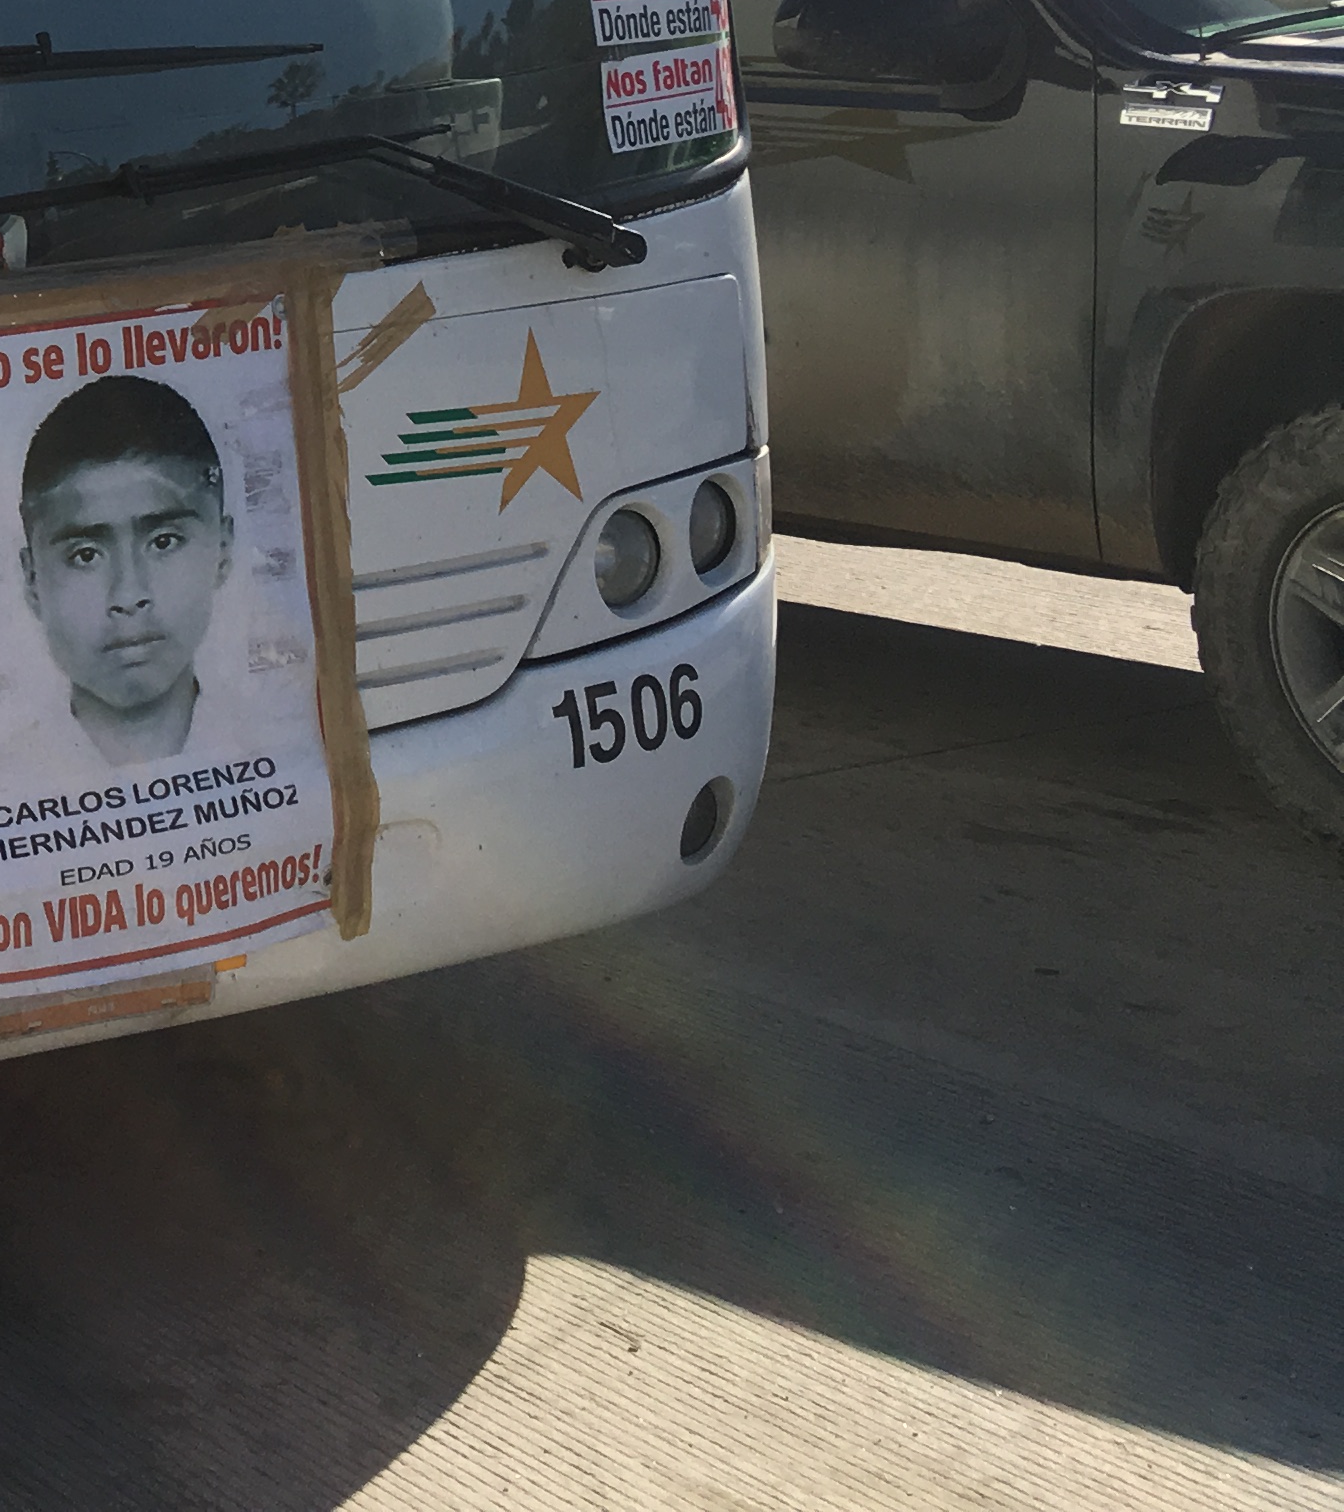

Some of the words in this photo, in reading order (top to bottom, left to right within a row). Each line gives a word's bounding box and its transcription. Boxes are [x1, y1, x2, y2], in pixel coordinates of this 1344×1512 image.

[598, 5, 661, 42] Dónde
[606, 68, 647, 100] Nos
[652, 58, 713, 92] faltan
[611, 108, 670, 149] Dónde
[674, 99, 717, 138] están
[1125, 114, 1207, 128] TERRAIN
[22, 344, 64, 384] se
[75, 332, 111, 377] lo
[122, 312, 284, 370] llevaron!
[551, 662, 703, 769] 1506
[133, 756, 277, 805] LORENZO
[194, 784, 299, 826] MUÑOZ
[60, 859, 134, 887] EDAD
[145, 850, 174, 872] 19
[183, 833, 252, 864] AÑOS
[42, 888, 128, 943] VIDA
[135, 883, 166, 927] lo
[175, 843, 323, 926] queremos!
